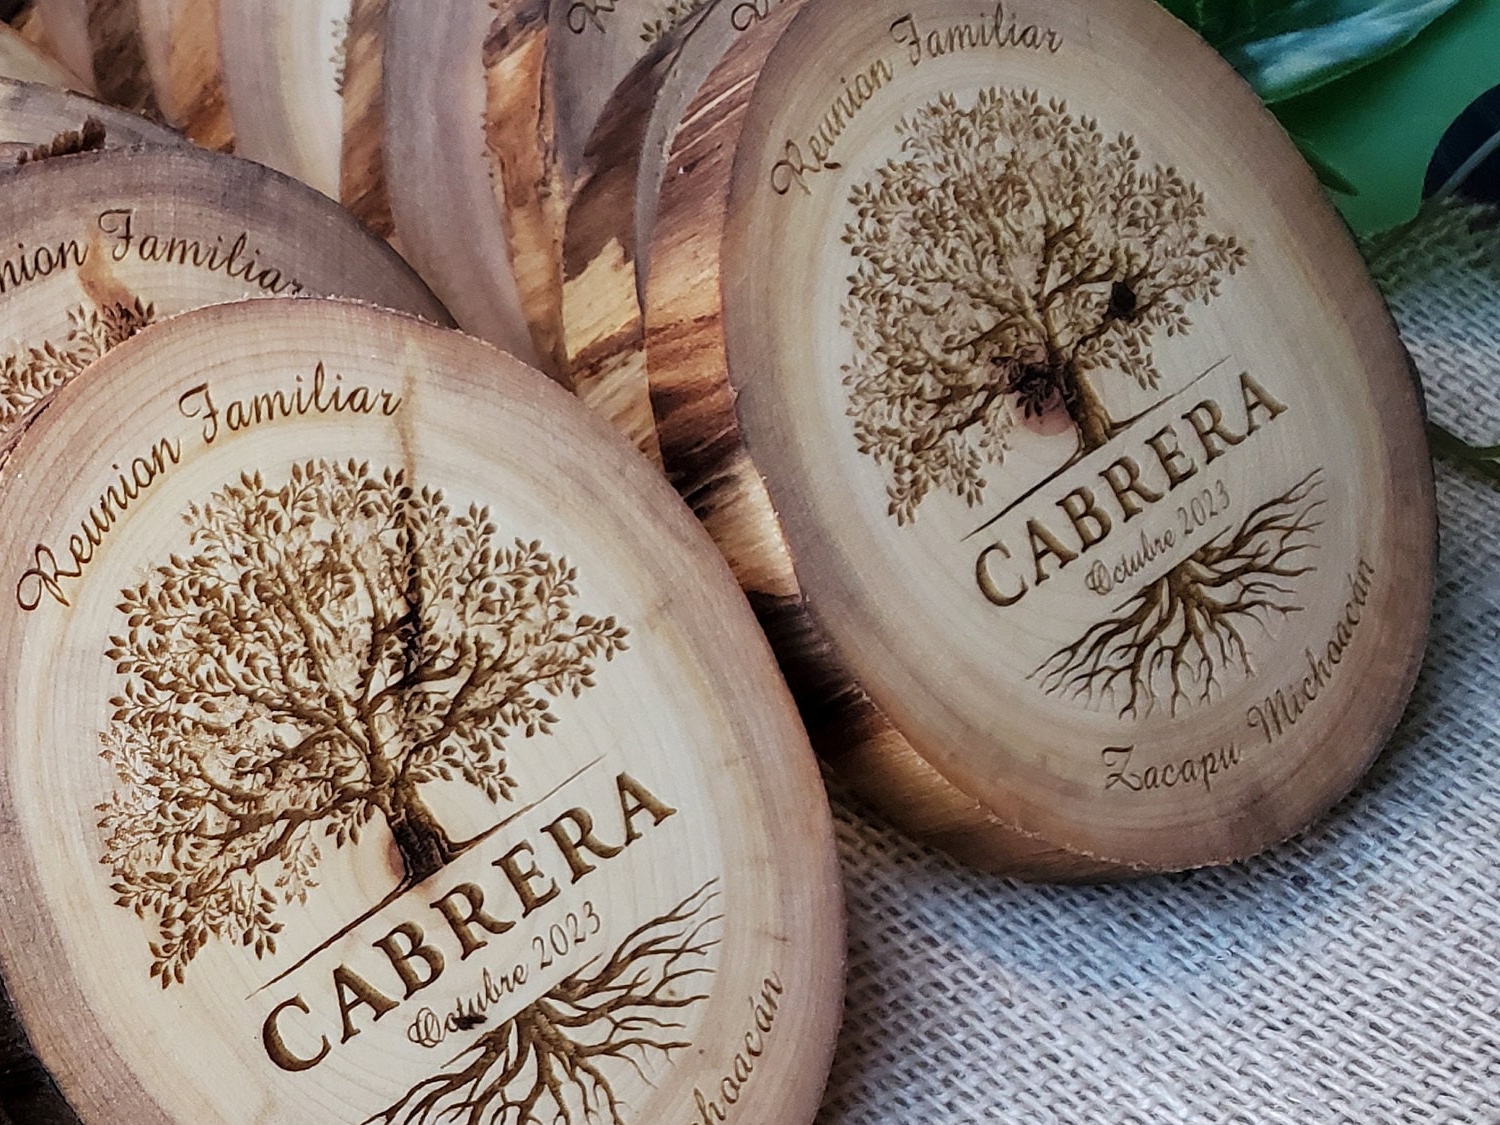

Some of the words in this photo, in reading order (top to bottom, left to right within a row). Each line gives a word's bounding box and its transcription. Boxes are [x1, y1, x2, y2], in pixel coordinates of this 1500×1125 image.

[770, 56, 893, 196] Reunion
[890, 1, 1063, 66] Familiar
[16, 437, 181, 611] Reunion
[178, 360, 403, 444] Familiar
[975, 370, 1289, 607] CABRERA
[1084, 525, 1177, 597] Octubre
[1177, 478, 1233, 540] 2023
[1101, 740, 1243, 793] Zacapu
[1246, 557, 1377, 744] Michoacán
[262, 770, 679, 1073] CABRERA
[407, 963, 531, 1049] Octubre
[531, 900, 603, 969] 2023
